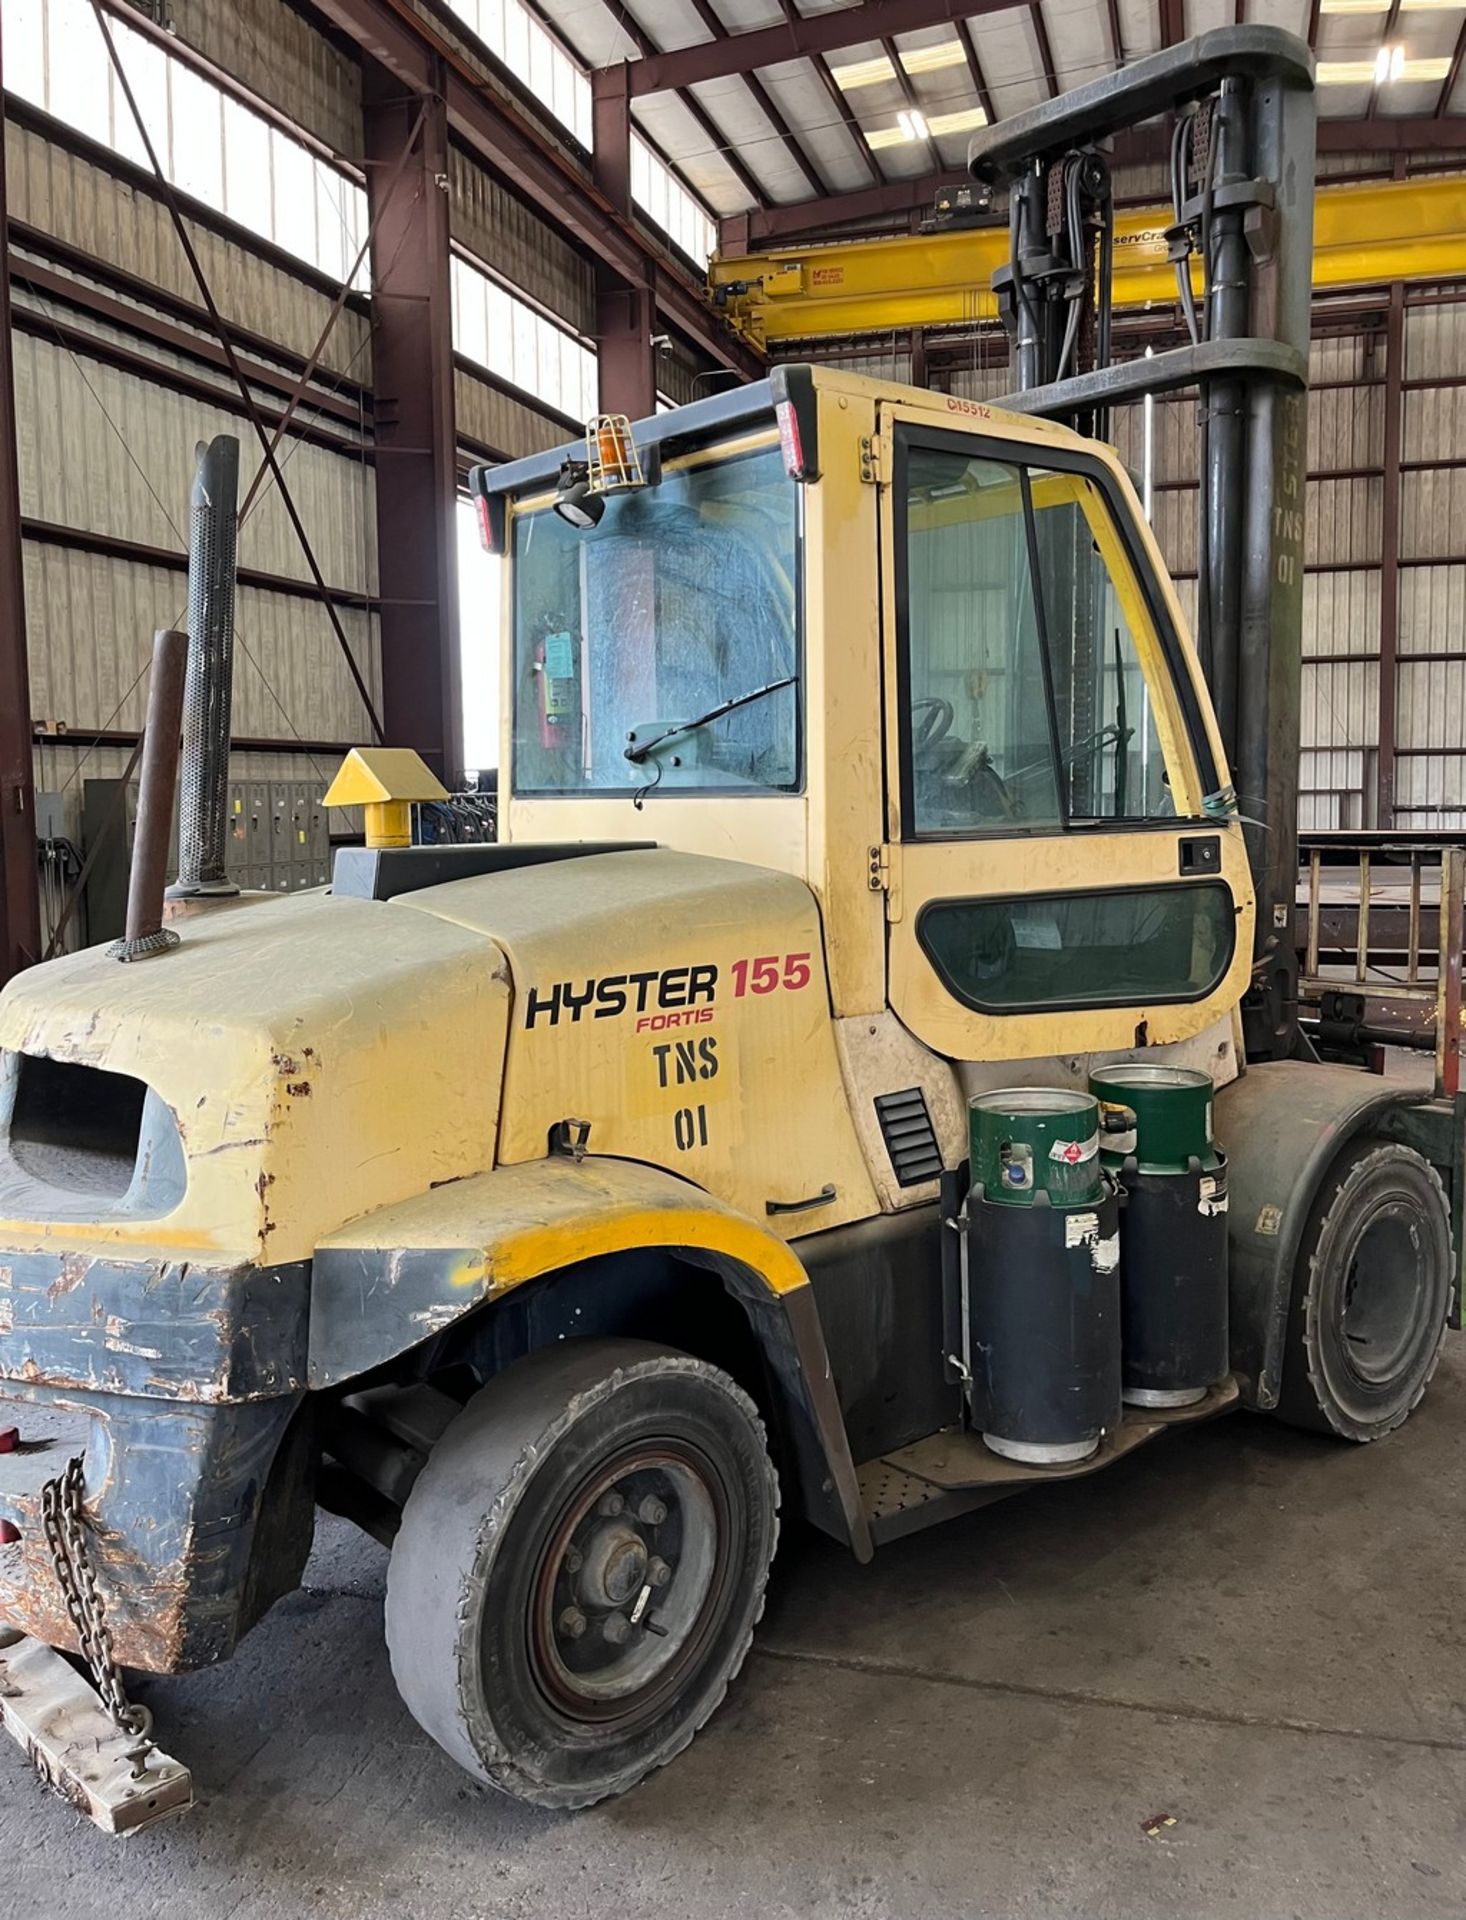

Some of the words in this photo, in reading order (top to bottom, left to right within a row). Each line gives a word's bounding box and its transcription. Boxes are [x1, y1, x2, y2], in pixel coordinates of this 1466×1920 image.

[1274, 507, 1303, 542] TNS
[525, 964, 718, 1029] HYSTER
[731, 953, 811, 998] 155
[635, 1007, 714, 1033] FORTIS
[652, 1036, 719, 1088] TNS
